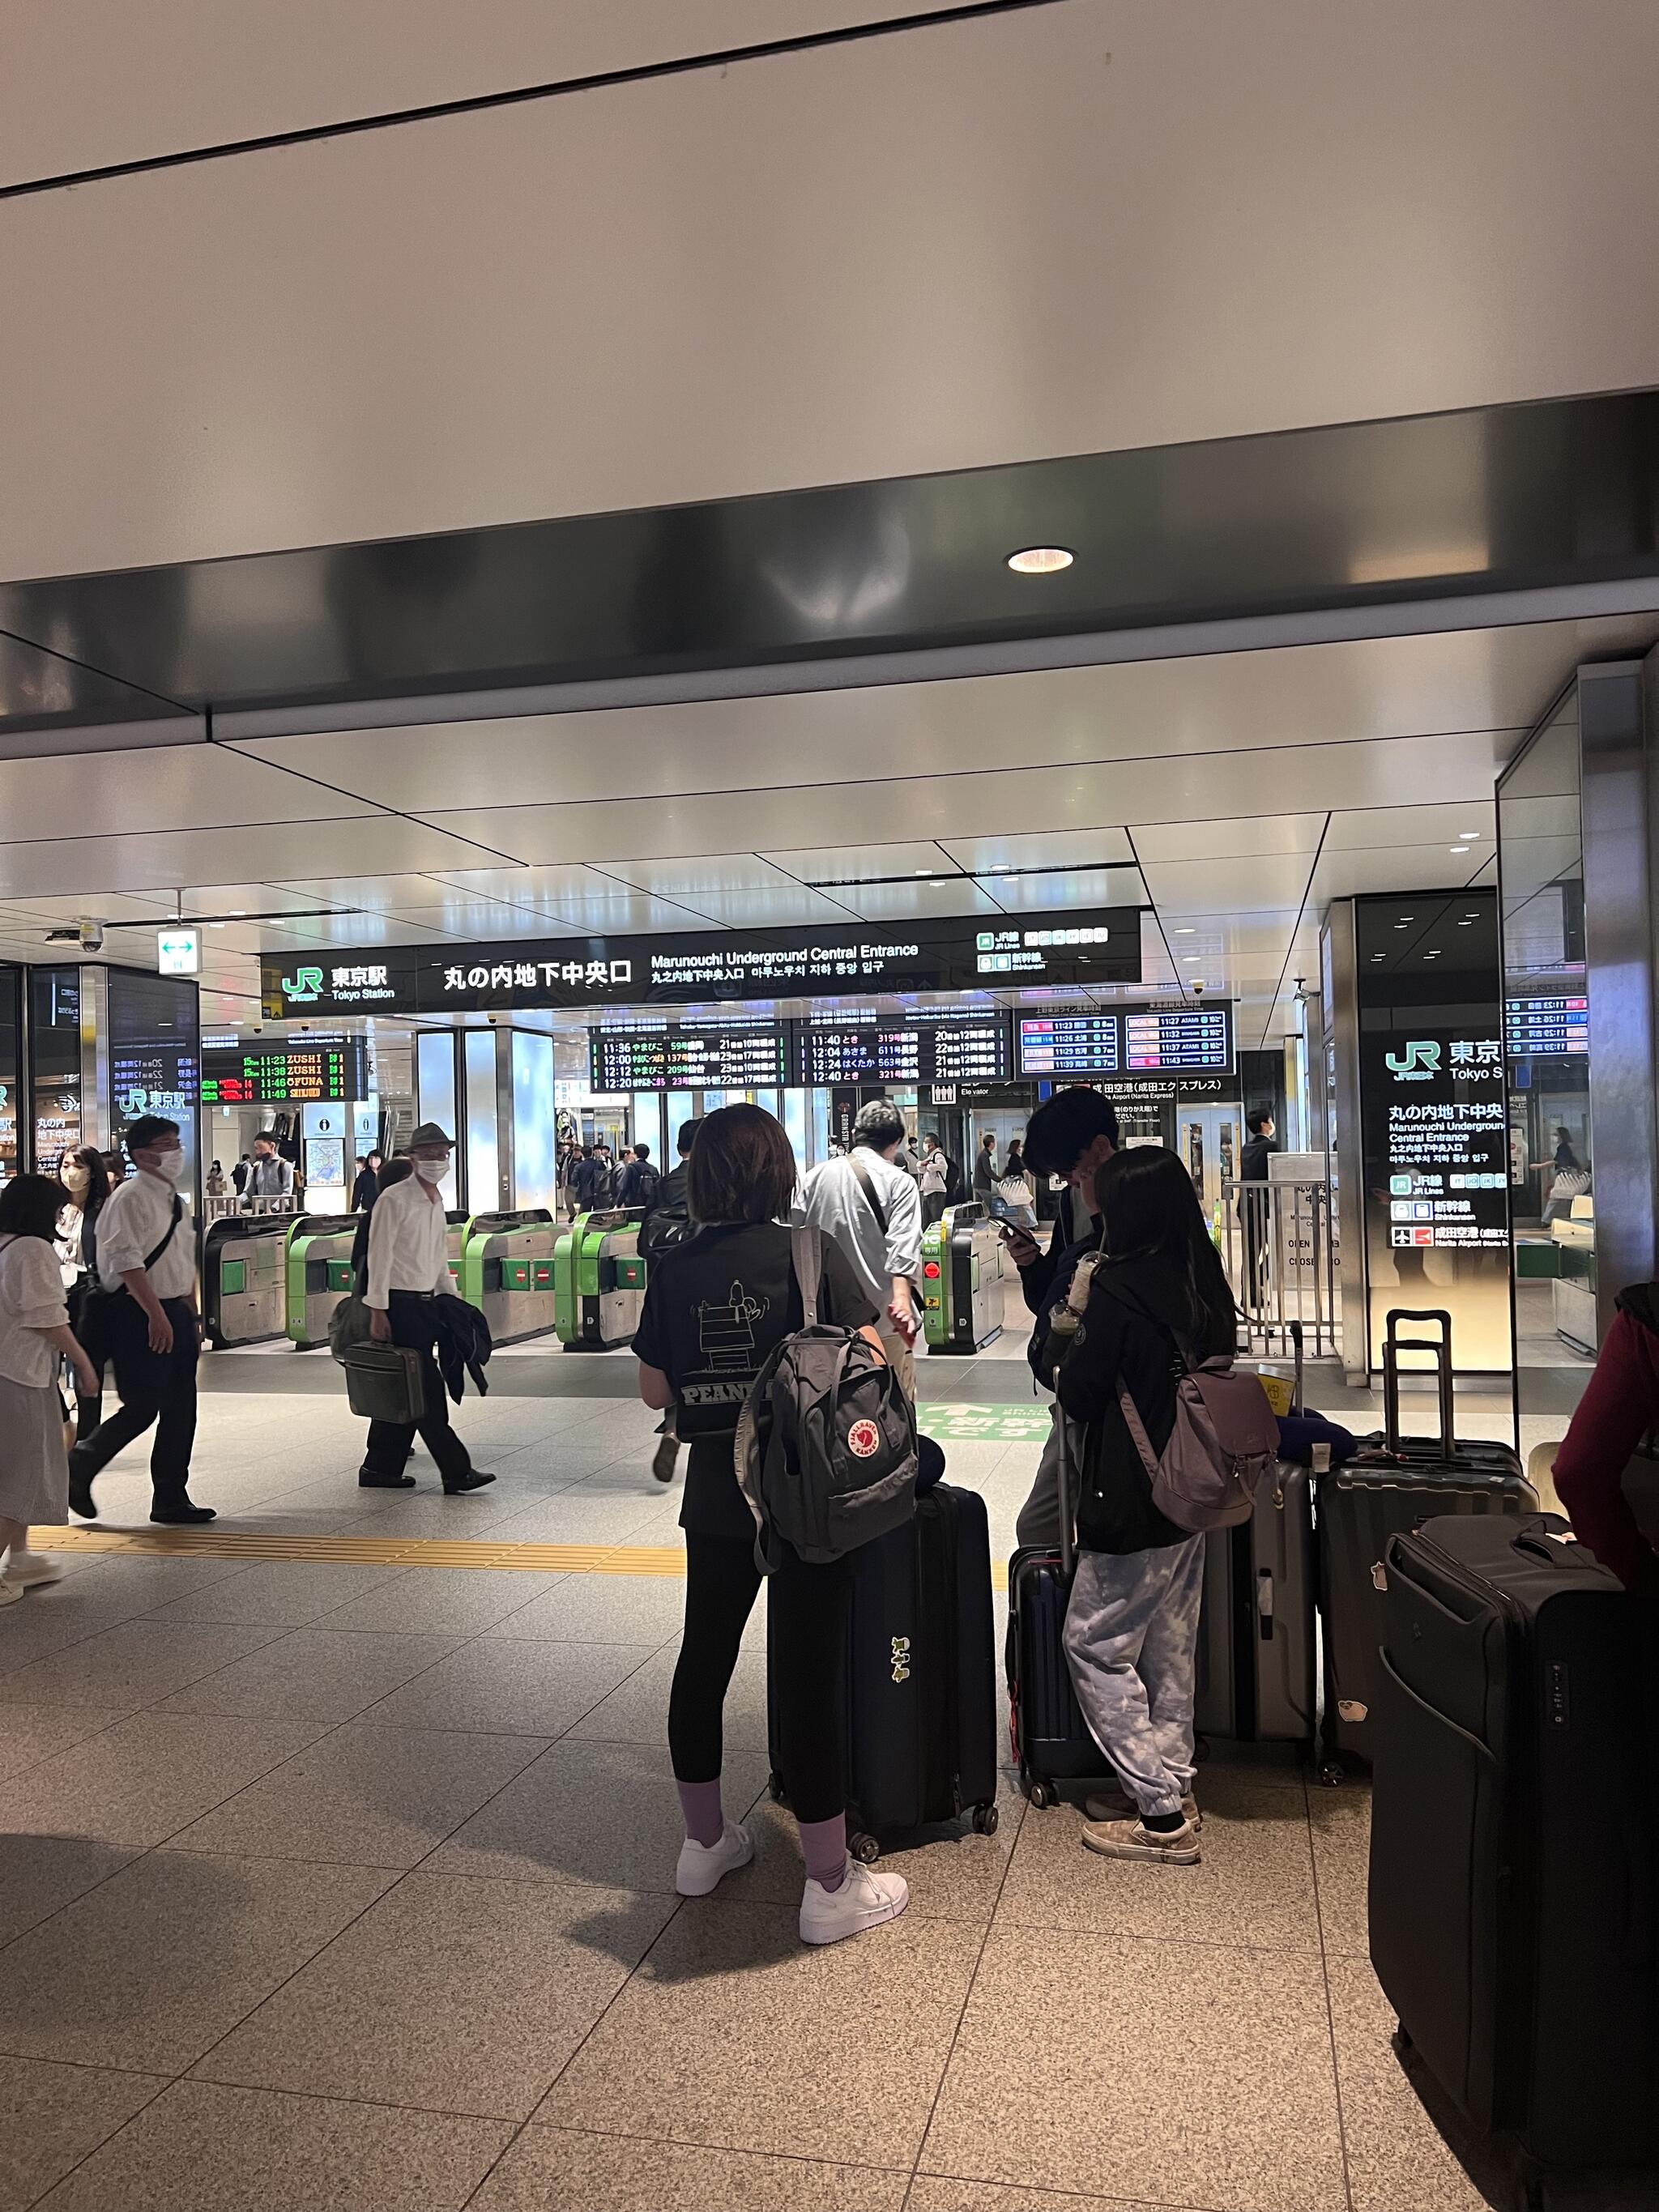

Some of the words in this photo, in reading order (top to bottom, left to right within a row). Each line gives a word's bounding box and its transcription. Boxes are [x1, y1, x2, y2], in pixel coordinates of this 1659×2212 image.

[651, 953, 723, 968] Marunouchi
[727, 949, 808, 965] Underground
[810, 946, 856, 961] Central
[860, 944, 918, 957] Entrance
[444, 960, 631, 990] 丸の内地下中央口
[651, 968, 744, 983] 丸之内地下中央入口
[752, 965, 805, 978] 마루노우치
[810, 963, 831, 976] 지하
[836, 961, 857, 975] 중앙
[863, 961, 885, 974] 입구
[282, 967, 323, 993] JR
[331, 966, 386, 987] 東京駅
[331, 990, 360, 1002] Tokyo
[362, 988, 394, 999] Station
[812, 1035, 841, 1046] 11:40
[842, 1036, 858, 1044] とき
[877, 1034, 901, 1042] 319号
[603, 1042, 631, 1053] 11:36
[633, 1042, 663, 1051] やまびこ
[671, 1042, 687, 1051] 59号
[812, 1047, 841, 1059] 12:04
[842, 1046, 867, 1056] あさま
[878, 1046, 901, 1055] 611号
[901, 1045, 919, 1055] 長野
[1448, 1039, 1501, 1064] 東京
[261, 1055, 286, 1065] 11:23
[287, 1054, 322, 1064] ZUSHI
[604, 1055, 632, 1065] 12:00
[667, 1054, 688, 1062] 137号
[1386, 1041, 1442, 1072] JR
[604, 1066, 631, 1077] 12:12
[633, 1066, 664, 1075] やまびこ
[667, 1065, 689, 1074] 209号
[689, 1063, 705, 1074] 仙台
[812, 1059, 841, 1070] 12:24
[842, 1059, 875, 1068] はくたか
[878, 1058, 901, 1067] 563号
[901, 1057, 919, 1068] 金沢
[261, 1067, 286, 1076] 11:38
[287, 1066, 322, 1076] ZUSHI
[813, 1071, 842, 1082] 12:40
[843, 1072, 859, 1080] とき
[879, 1070, 902, 1079] 321号
[1449, 1068, 1490, 1081] Tokyo
[261, 1078, 286, 1088] 11:46
[604, 1078, 632, 1089] 12:20
[672, 1076, 689, 1086] 23号
[149, 1090, 186, 1110] 東京駅
[261, 1089, 287, 1099] 11:49
[1150, 1092, 1175, 1100] Express)
[119, 1089, 147, 1113] JR
[1388, 1102, 1503, 1121] 丸の内地下中央
[37, 1117, 65, 1128] 丸の内
[841, 1114, 850, 1141] GRANSTA
[1388, 1122, 1445, 1132] Marunouchi
[37, 1129, 79, 1140] 地下中央口
[1388, 1133, 1424, 1143] Central
[1427, 1133, 1469, 1142] Entrance
[1389, 1144, 1463, 1153] 丸之内地下中央入口
[1433, 1153, 1450, 1163] 지하
[1472, 1153, 1489, 1163] 입구
[1395, 1180, 1407, 1190] JR
[1413, 1174, 1443, 1187] JR線
[1413, 1187, 1424, 1196] JR
[1424, 1187, 1444, 1196] Lines
[1434, 1200, 1471, 1213] 新幹線
[1288, 1240, 1310, 1248] OEN
[1457, 1239, 1482, 1248] Airport
[681, 1380, 773, 1404] PEAN
